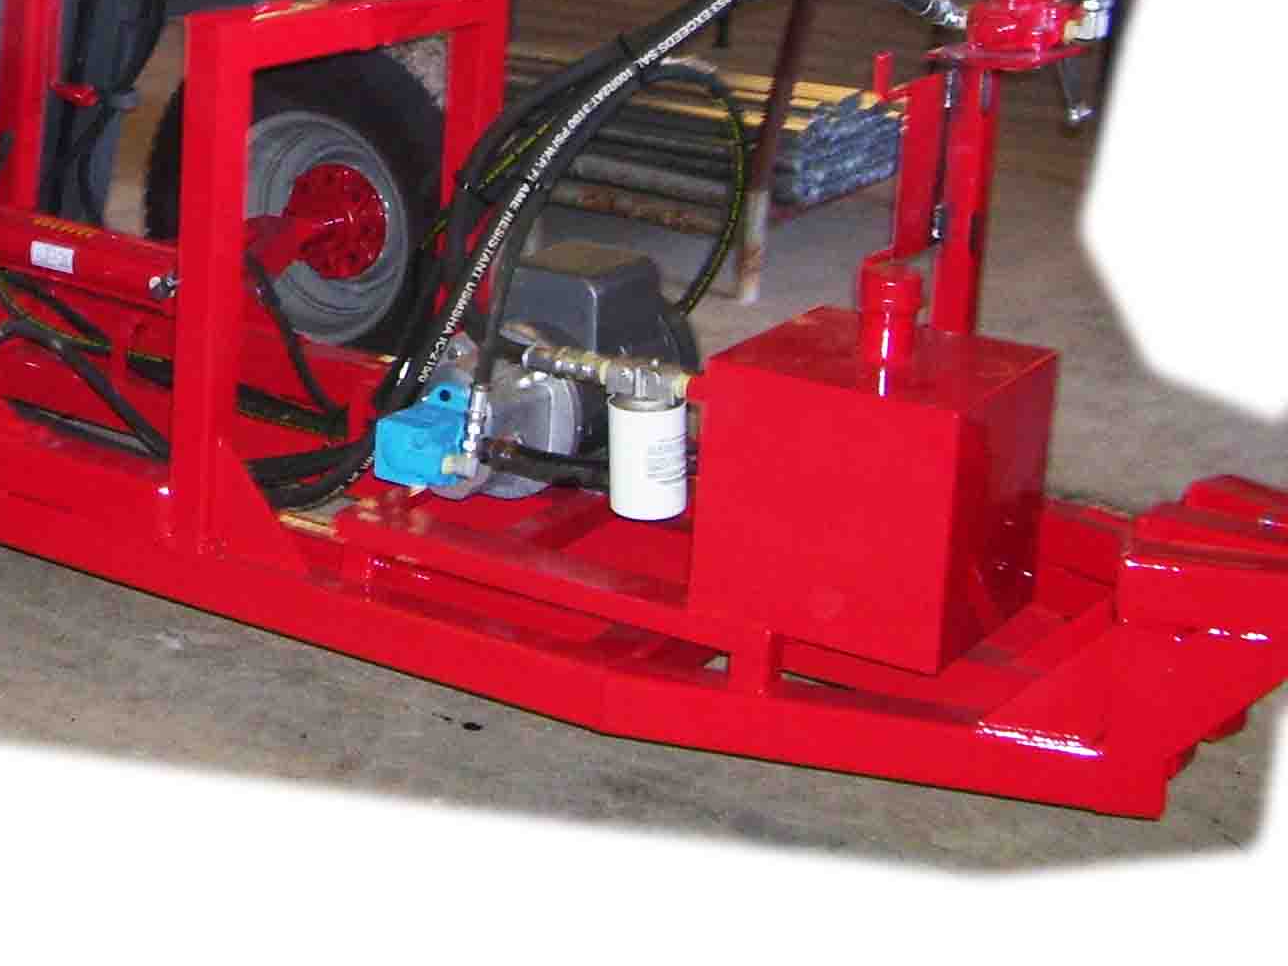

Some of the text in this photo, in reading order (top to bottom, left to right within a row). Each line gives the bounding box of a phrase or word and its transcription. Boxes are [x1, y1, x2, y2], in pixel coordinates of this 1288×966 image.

[657, 9, 711, 52] EXCEEDS
[472, 211, 513, 278] RESISTANT
[443, 281, 475, 333] USMSHA
